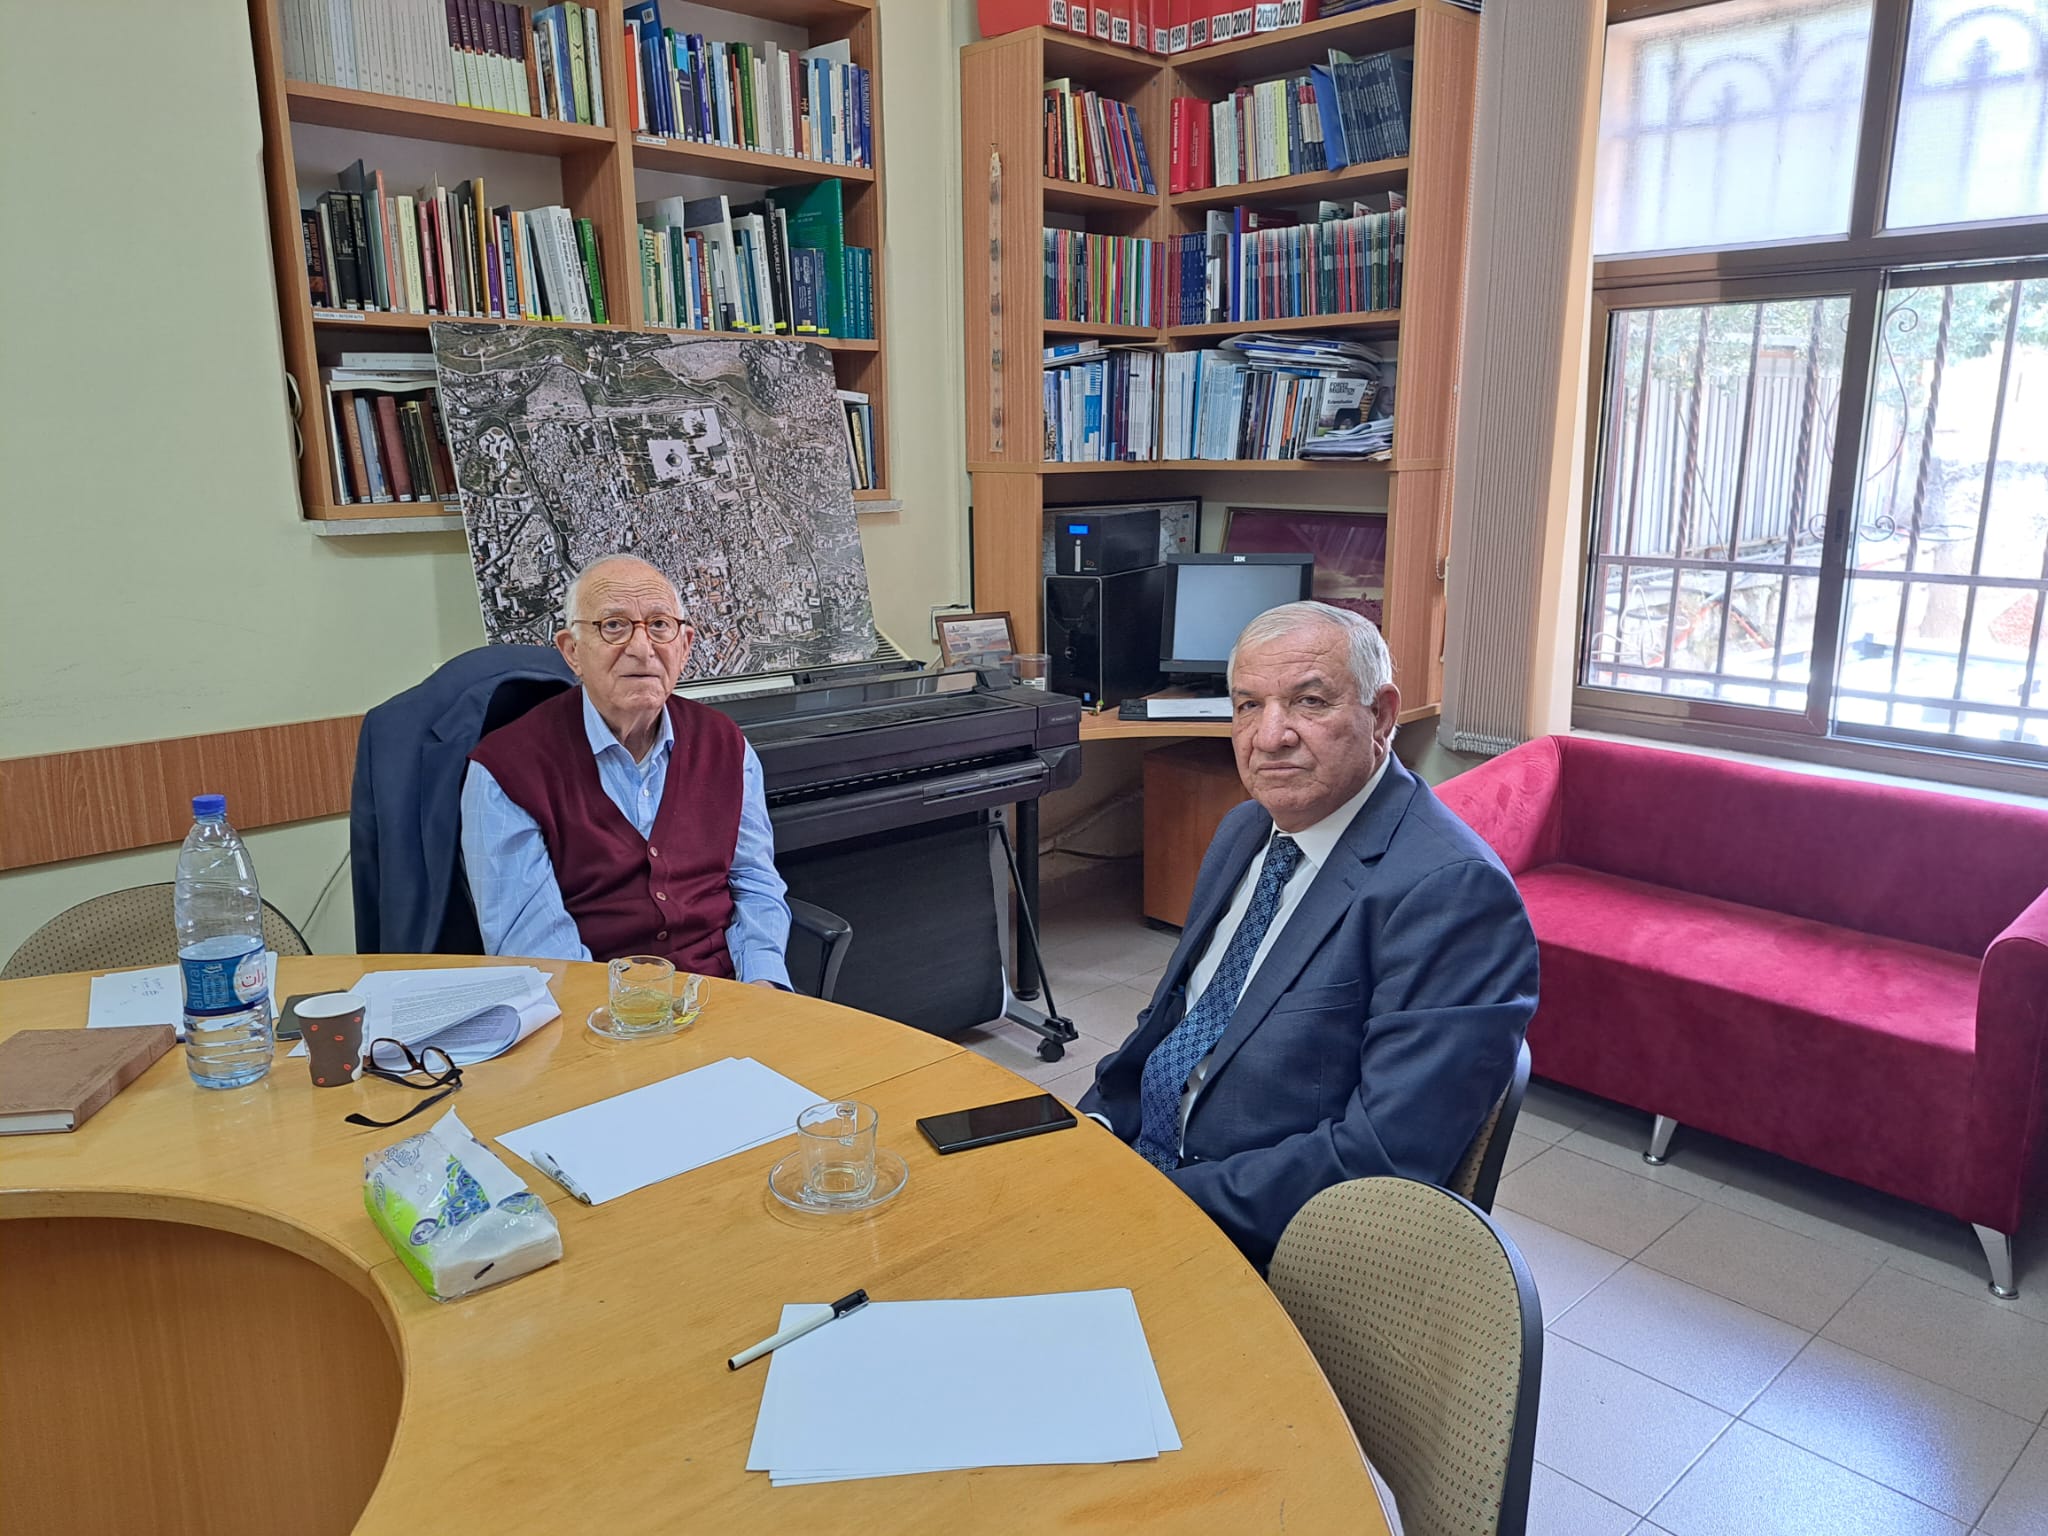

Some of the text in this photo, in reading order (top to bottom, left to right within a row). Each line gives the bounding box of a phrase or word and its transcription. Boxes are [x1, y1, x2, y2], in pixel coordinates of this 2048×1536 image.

[1232, 10, 1251, 35] 2001
[1256, 7, 1278, 28] 2002
[1280, 0, 1301, 26] 2003
[1114, 19, 1128, 42] 1995
[1192, 19, 1205, 44] 1999
[1213, 15, 1230, 39] 2000
[645, 237, 656, 269] ISLAM
